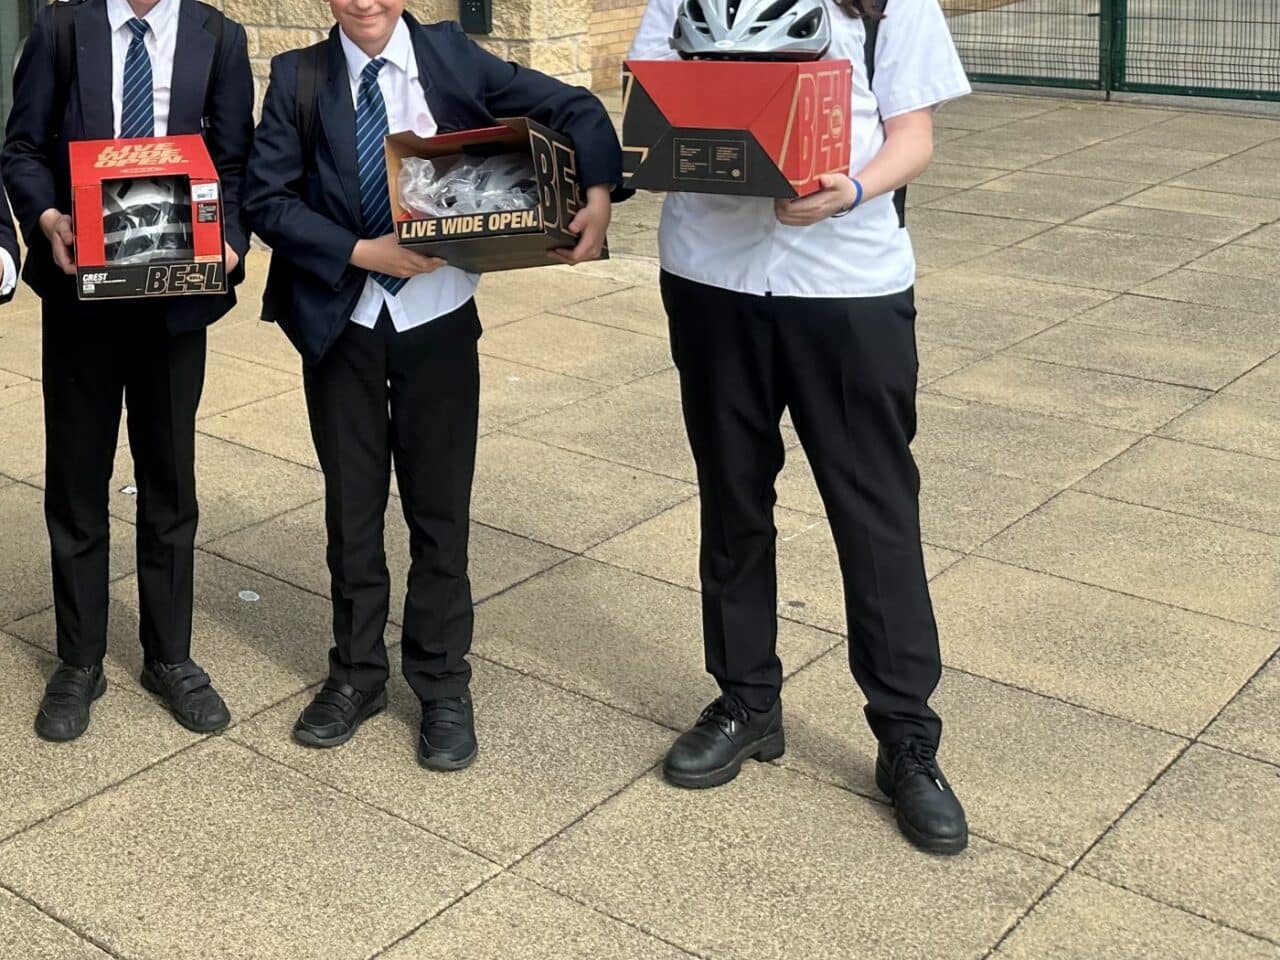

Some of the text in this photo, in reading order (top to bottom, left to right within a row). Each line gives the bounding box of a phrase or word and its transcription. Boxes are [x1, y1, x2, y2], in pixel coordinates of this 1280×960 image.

[401, 210, 538, 239] LIVE WIDE OPEN.
[82, 272, 109, 281] CREST
